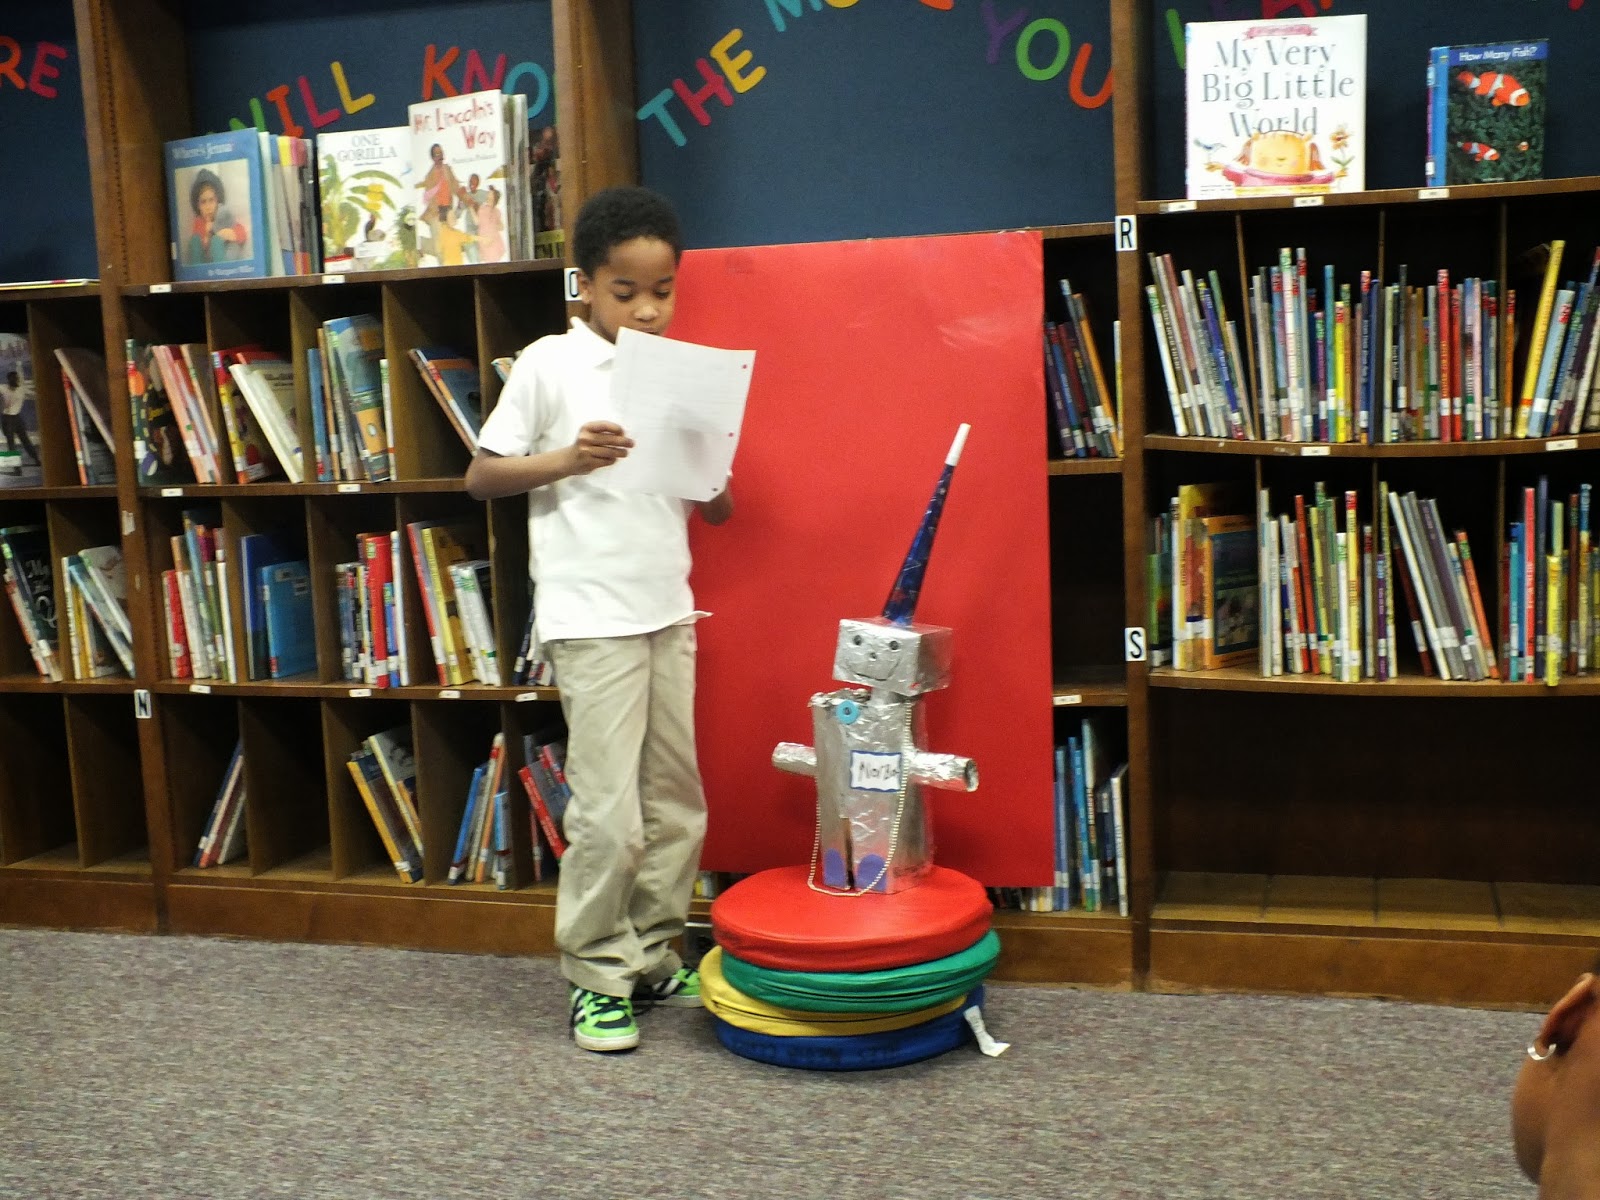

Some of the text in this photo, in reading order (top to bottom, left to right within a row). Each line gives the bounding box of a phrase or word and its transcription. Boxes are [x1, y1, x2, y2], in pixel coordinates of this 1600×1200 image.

[979, 0, 1112, 109] YOU
[1213, 38, 1258, 76] My
[1266, 36, 1336, 73] Very
[1458, 46, 1538, 62] How Many Fish?
[218, 61, 376, 137] ILL
[422, 43, 557, 125] KNO
[636, 27, 767, 147] THE
[1202, 68, 1354, 109] Big Little
[461, 125, 496, 150] Way
[1229, 106, 1318, 138] World
[337, 146, 398, 162] GORILLA
[351, 133, 380, 147] ONE
[1120, 218, 1134, 248] R
[1130, 630, 1143, 660] S
[136, 691, 150, 717] N
